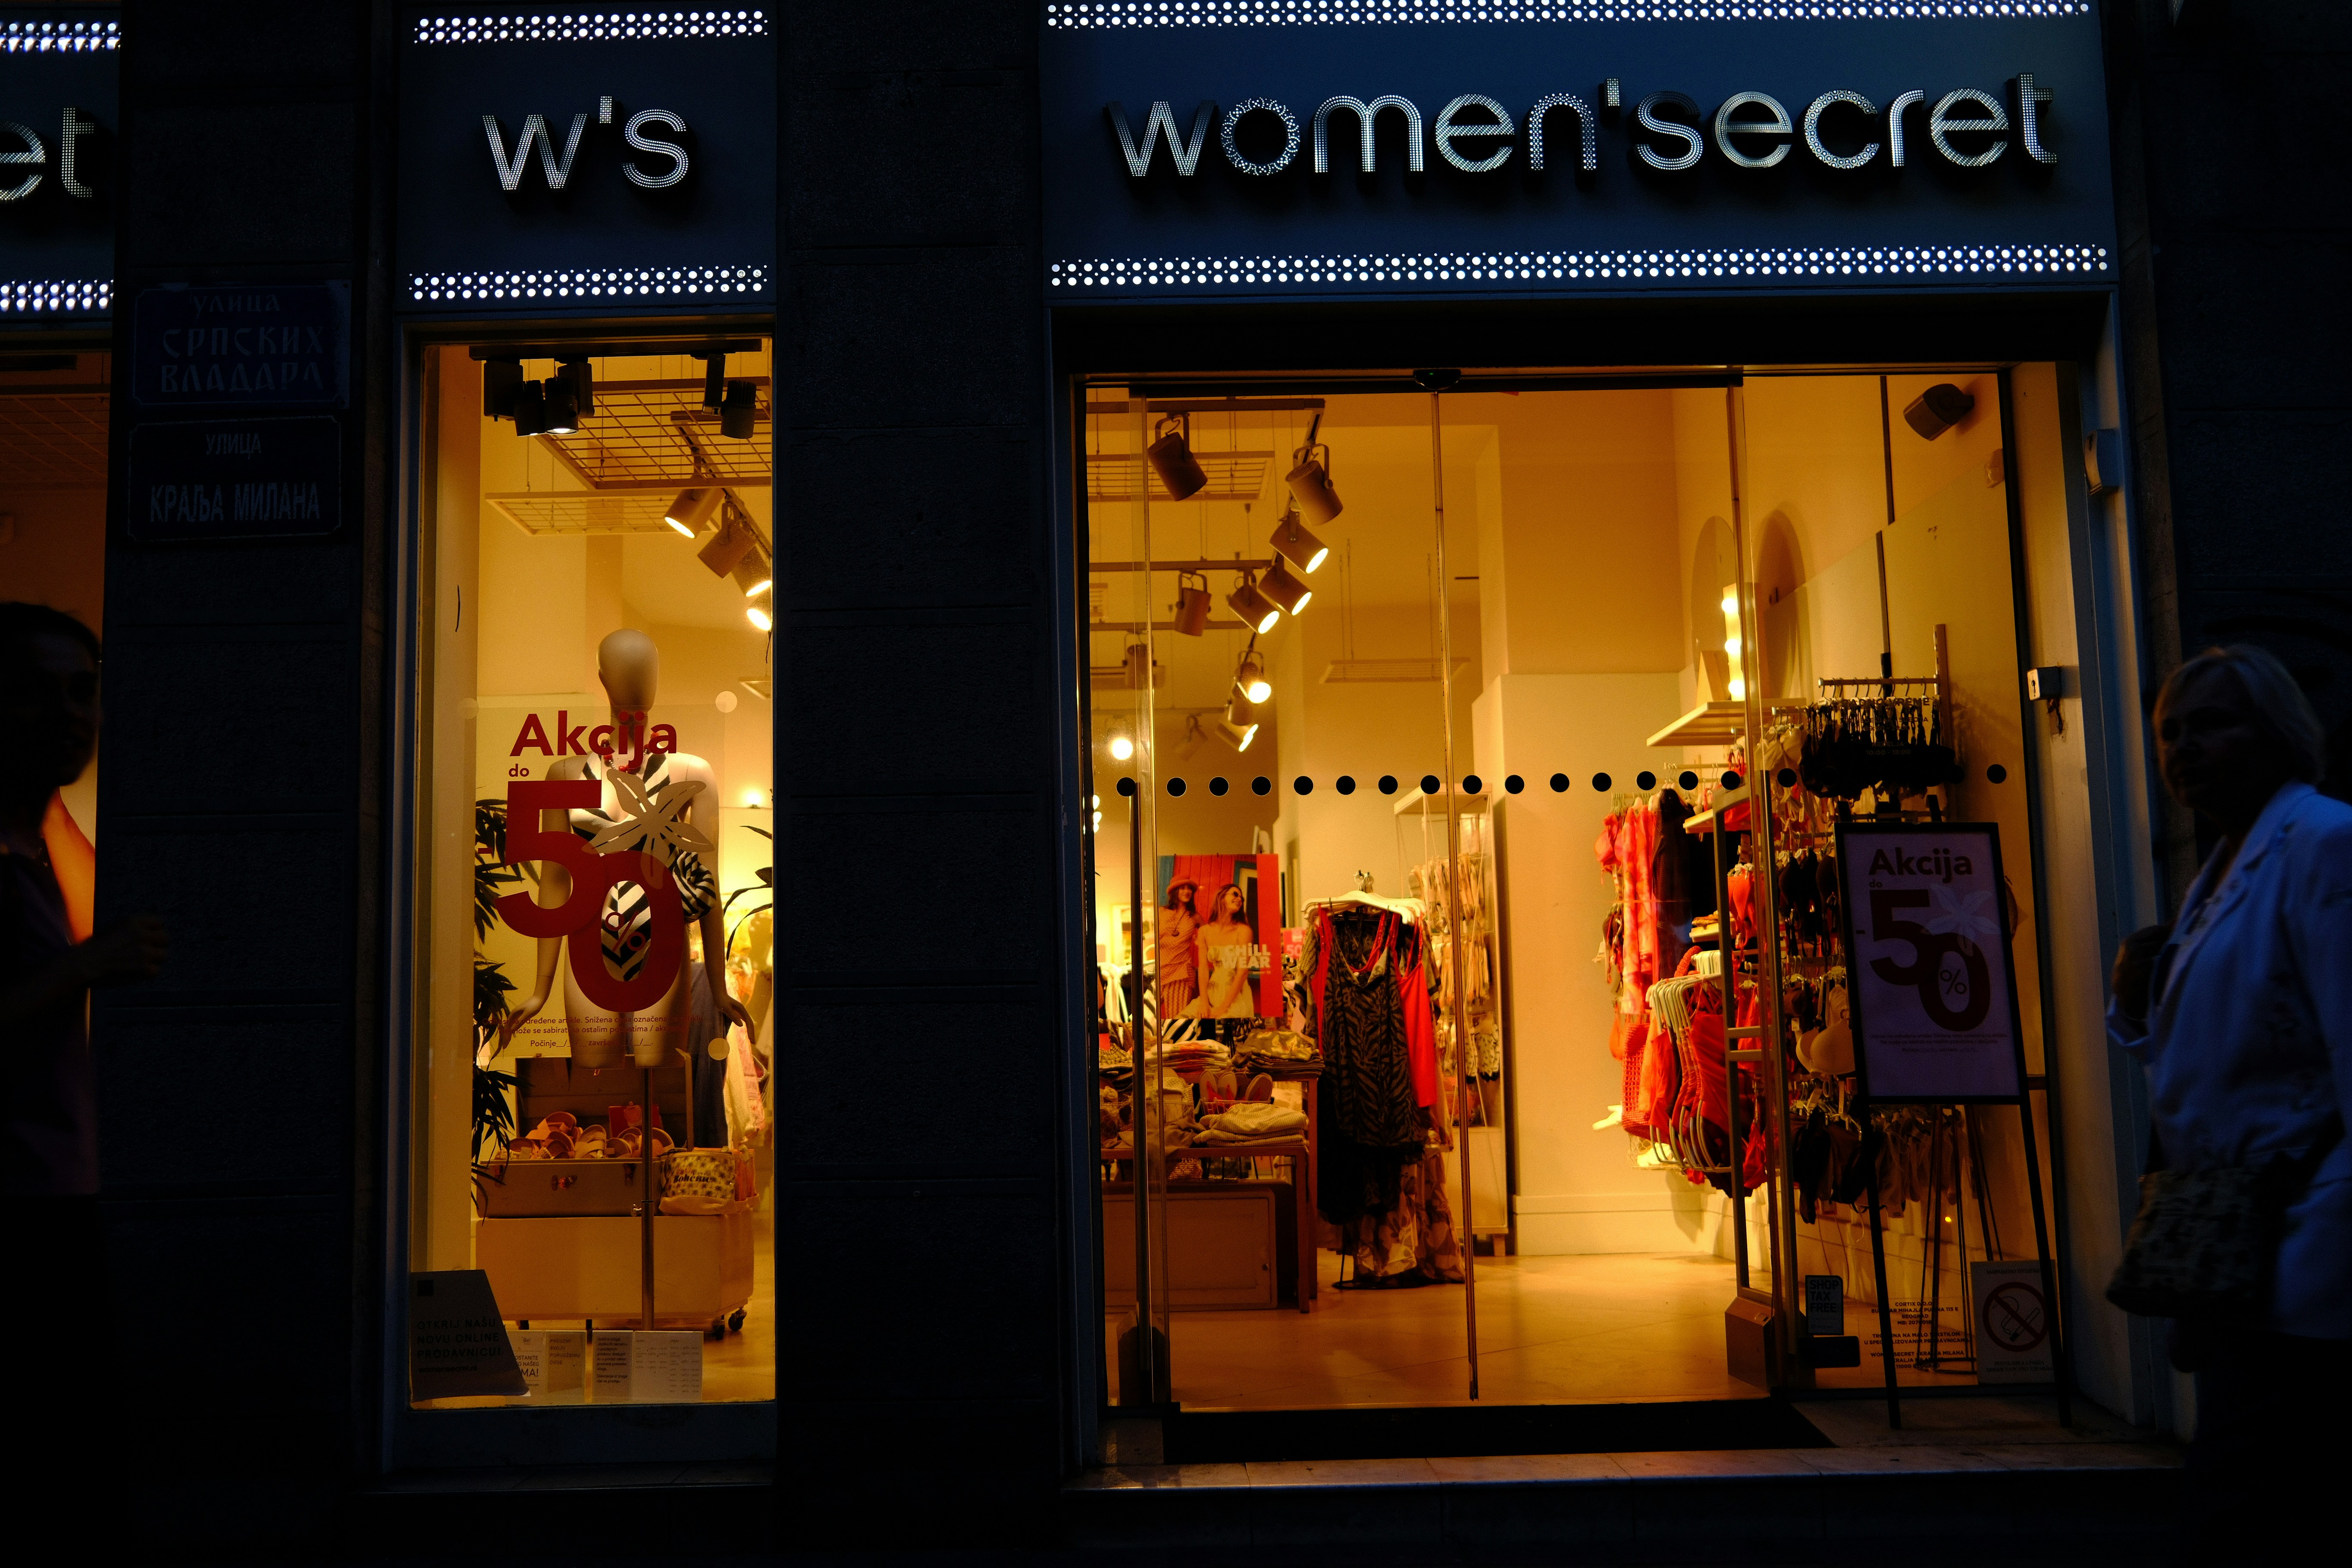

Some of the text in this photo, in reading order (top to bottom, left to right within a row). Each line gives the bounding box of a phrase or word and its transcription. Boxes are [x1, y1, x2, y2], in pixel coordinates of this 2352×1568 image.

[1103, 74, 2057, 181] women'secret
[162, 326, 324, 358] СРПСКИХ
[205, 432, 262, 459] УЛИЦА
[150, 482, 320, 523] КРАЉА МИЛАНА
[509, 710, 677, 770] Akcija
[508, 764, 530, 777] do
[1869, 847, 1972, 883] Akcija
[1869, 880, 1882, 888] do
[1221, 956, 1271, 968] WEAR
[1810, 1280, 1839, 1289] SHOP
[1810, 1291, 1830, 1301] TAX
[1810, 1302, 1837, 1313] FREE
[417, 1316, 496, 1330] OTKRIJ NAŠU
[417, 1332, 499, 1344] NOVU ONLINE
[417, 1347, 501, 1359] PRODAVNICU!
